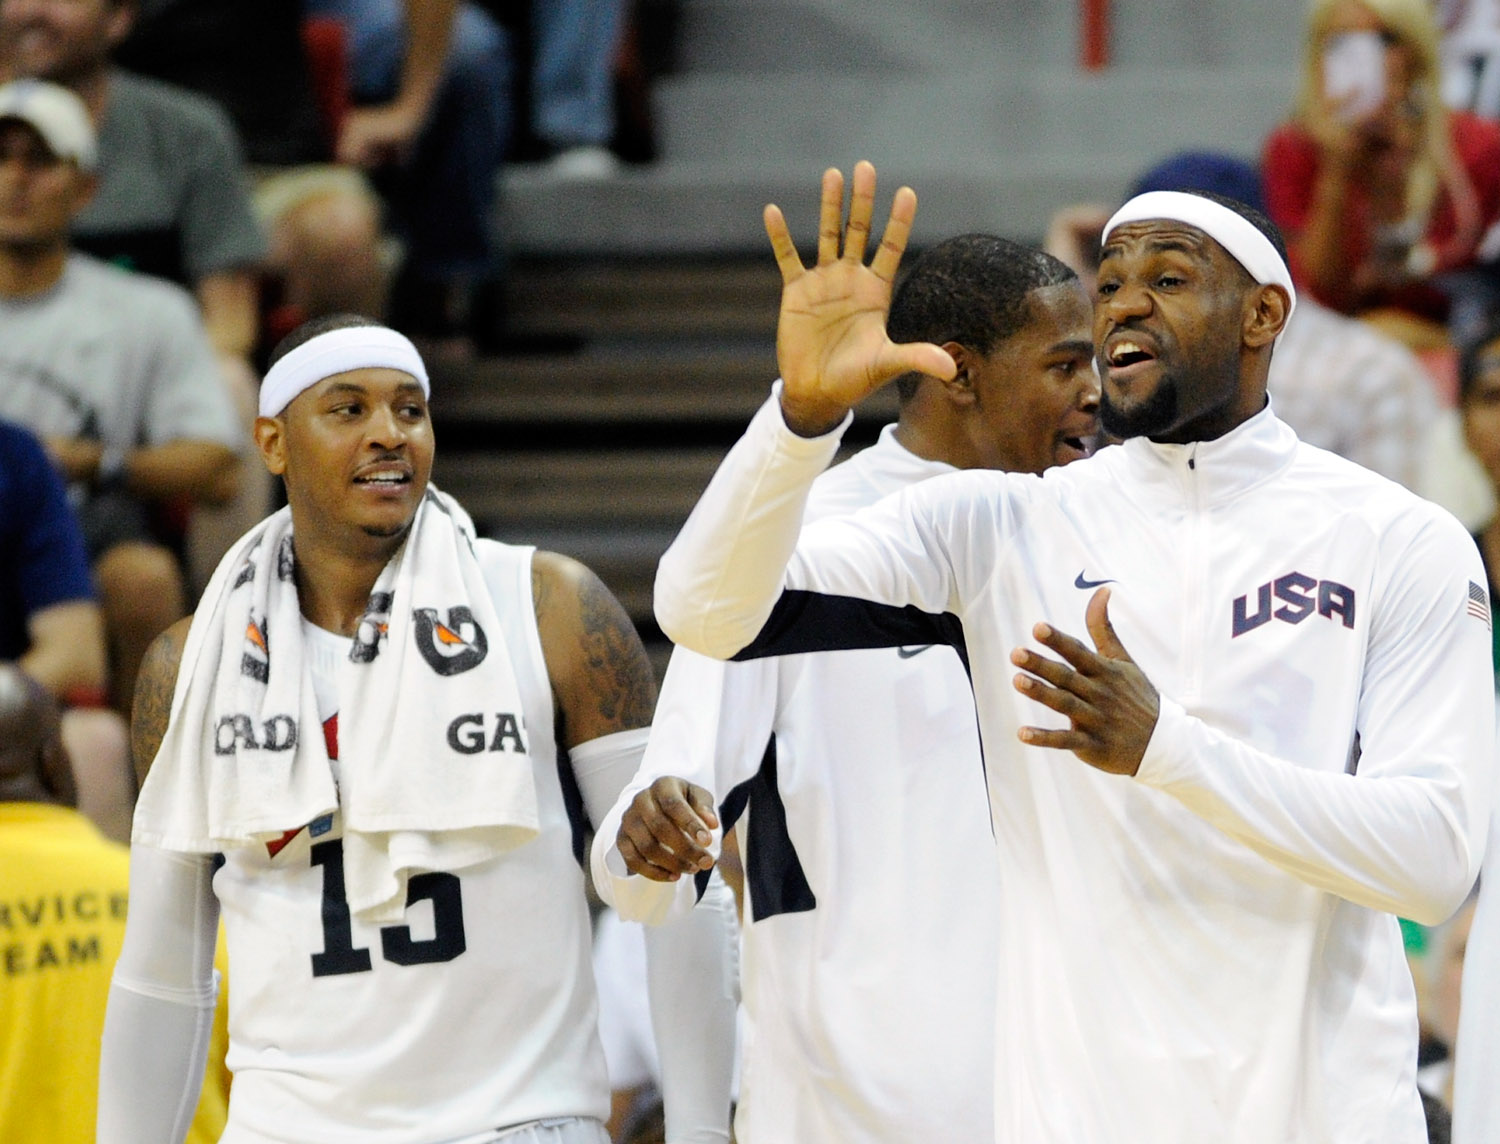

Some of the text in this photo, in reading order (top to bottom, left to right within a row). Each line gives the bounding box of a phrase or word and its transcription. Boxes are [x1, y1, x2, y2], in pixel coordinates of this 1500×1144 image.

[1231, 570, 1356, 639] USA
[446, 712, 527, 755] GA
[310, 837, 467, 978] 15
